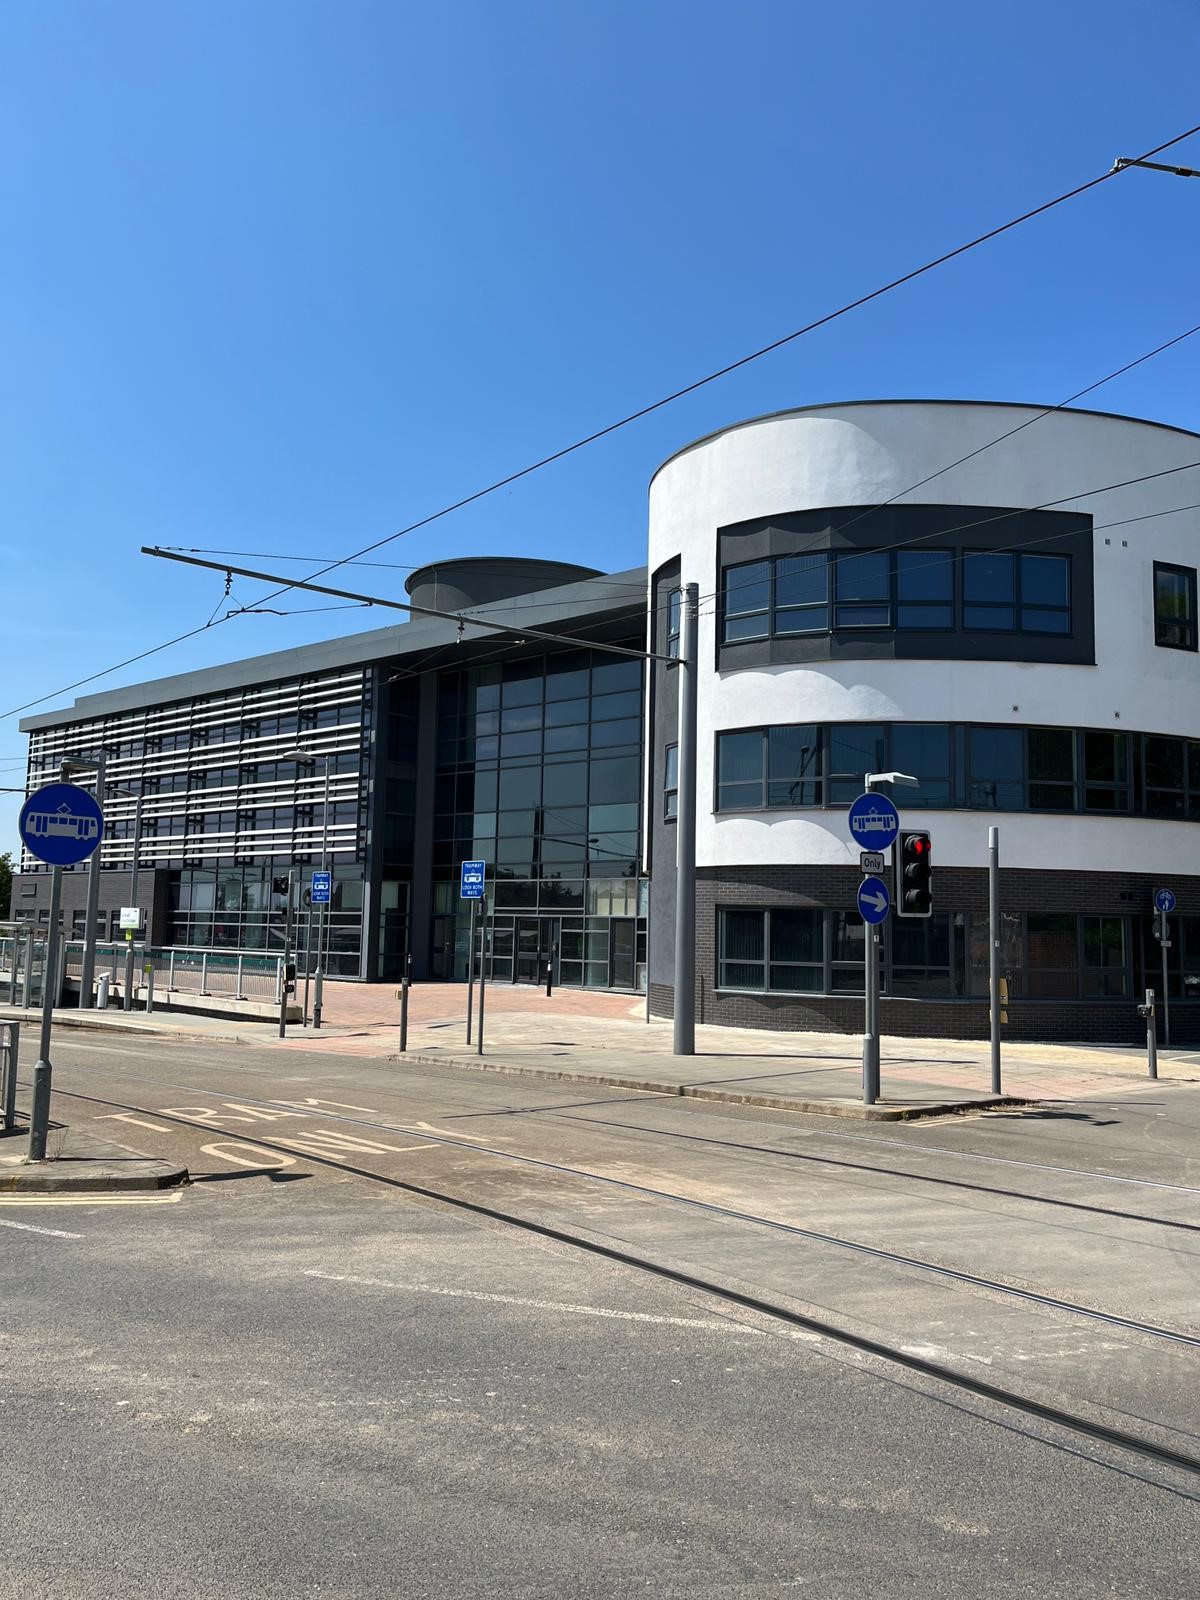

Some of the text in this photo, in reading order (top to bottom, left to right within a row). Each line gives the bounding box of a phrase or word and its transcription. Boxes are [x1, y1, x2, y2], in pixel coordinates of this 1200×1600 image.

[864, 857, 881, 870] Only
[93, 1098, 379, 1132] TRAM
[200, 1121, 491, 1168] ONLY
